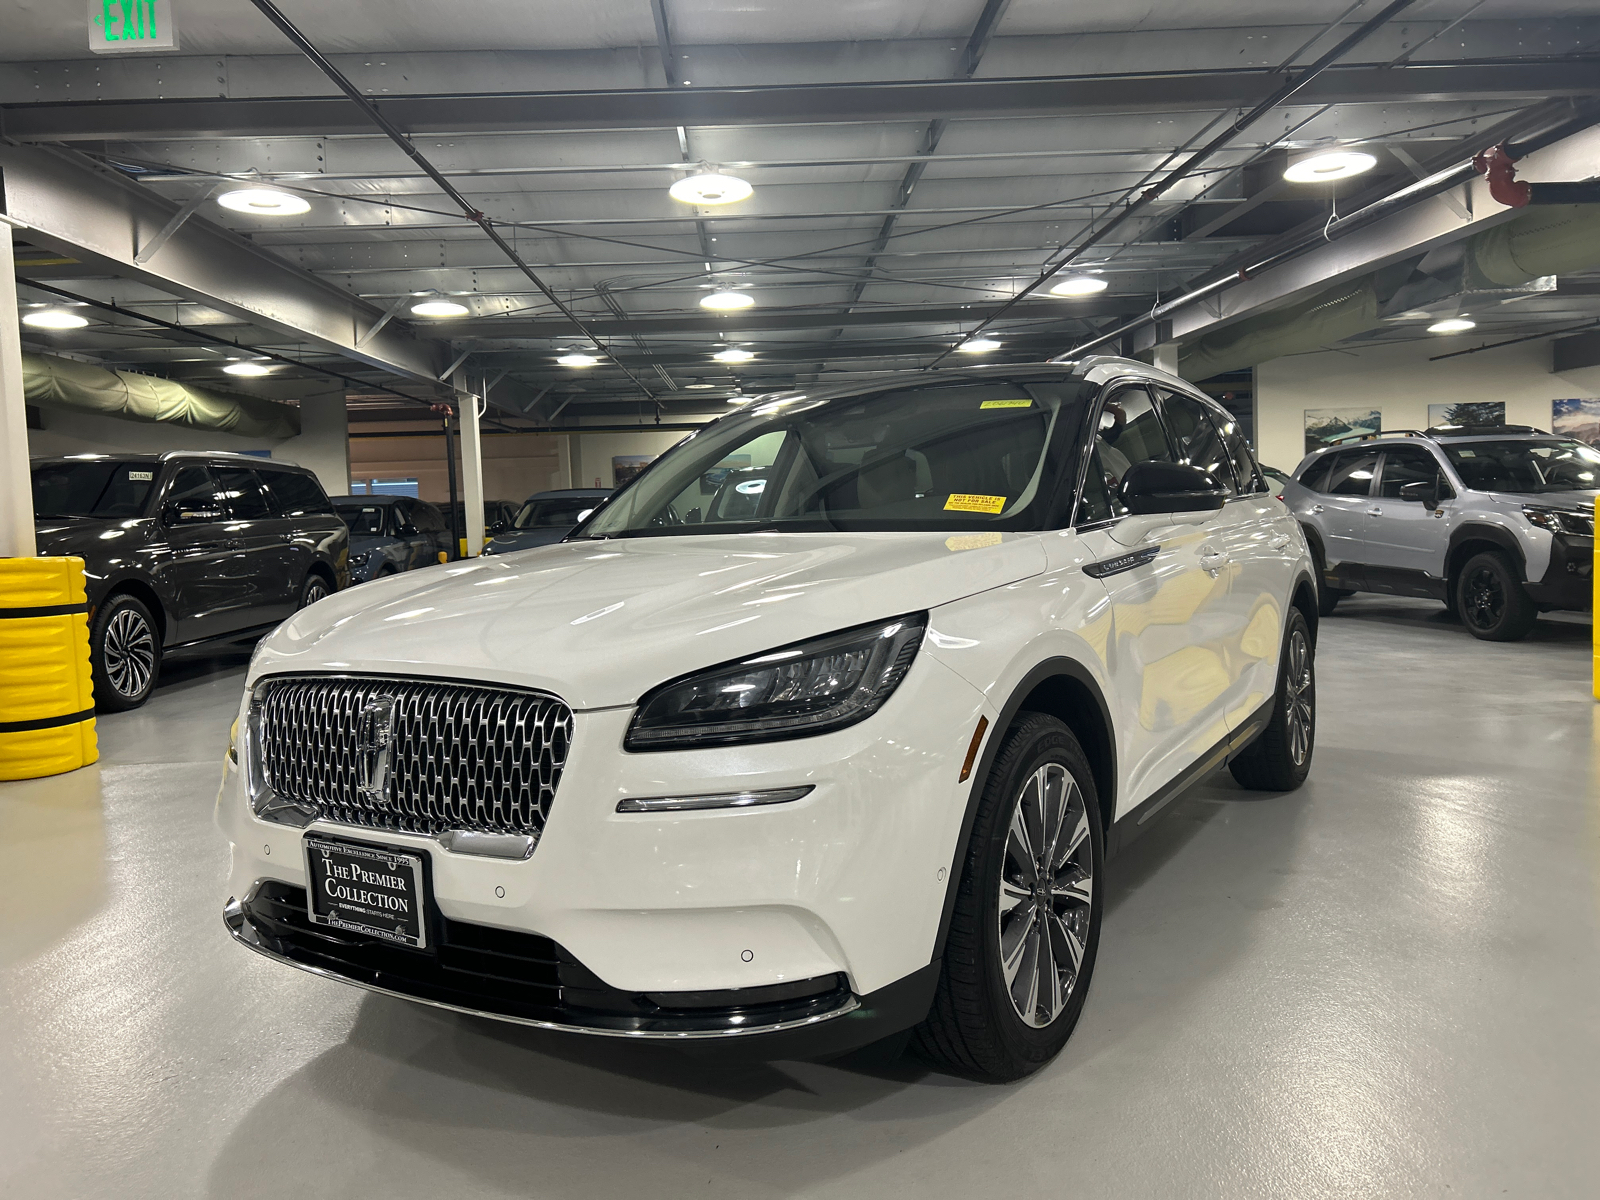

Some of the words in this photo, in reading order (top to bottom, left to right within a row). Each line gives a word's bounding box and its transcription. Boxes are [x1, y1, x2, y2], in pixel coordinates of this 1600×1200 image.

[103, 0, 157, 41] EXIT
[309, 841, 342, 852] AUTOMOTIVE
[342, 847, 375, 858] EXCELLENCE
[375, 853, 392, 862] SINCE
[394, 856, 409, 865] 1995
[321, 858, 350, 880] THE
[350, 863, 407, 891] PREMIER
[325, 877, 408, 912] COLLECTION
[338, 902, 366, 913] EVERYTHING
